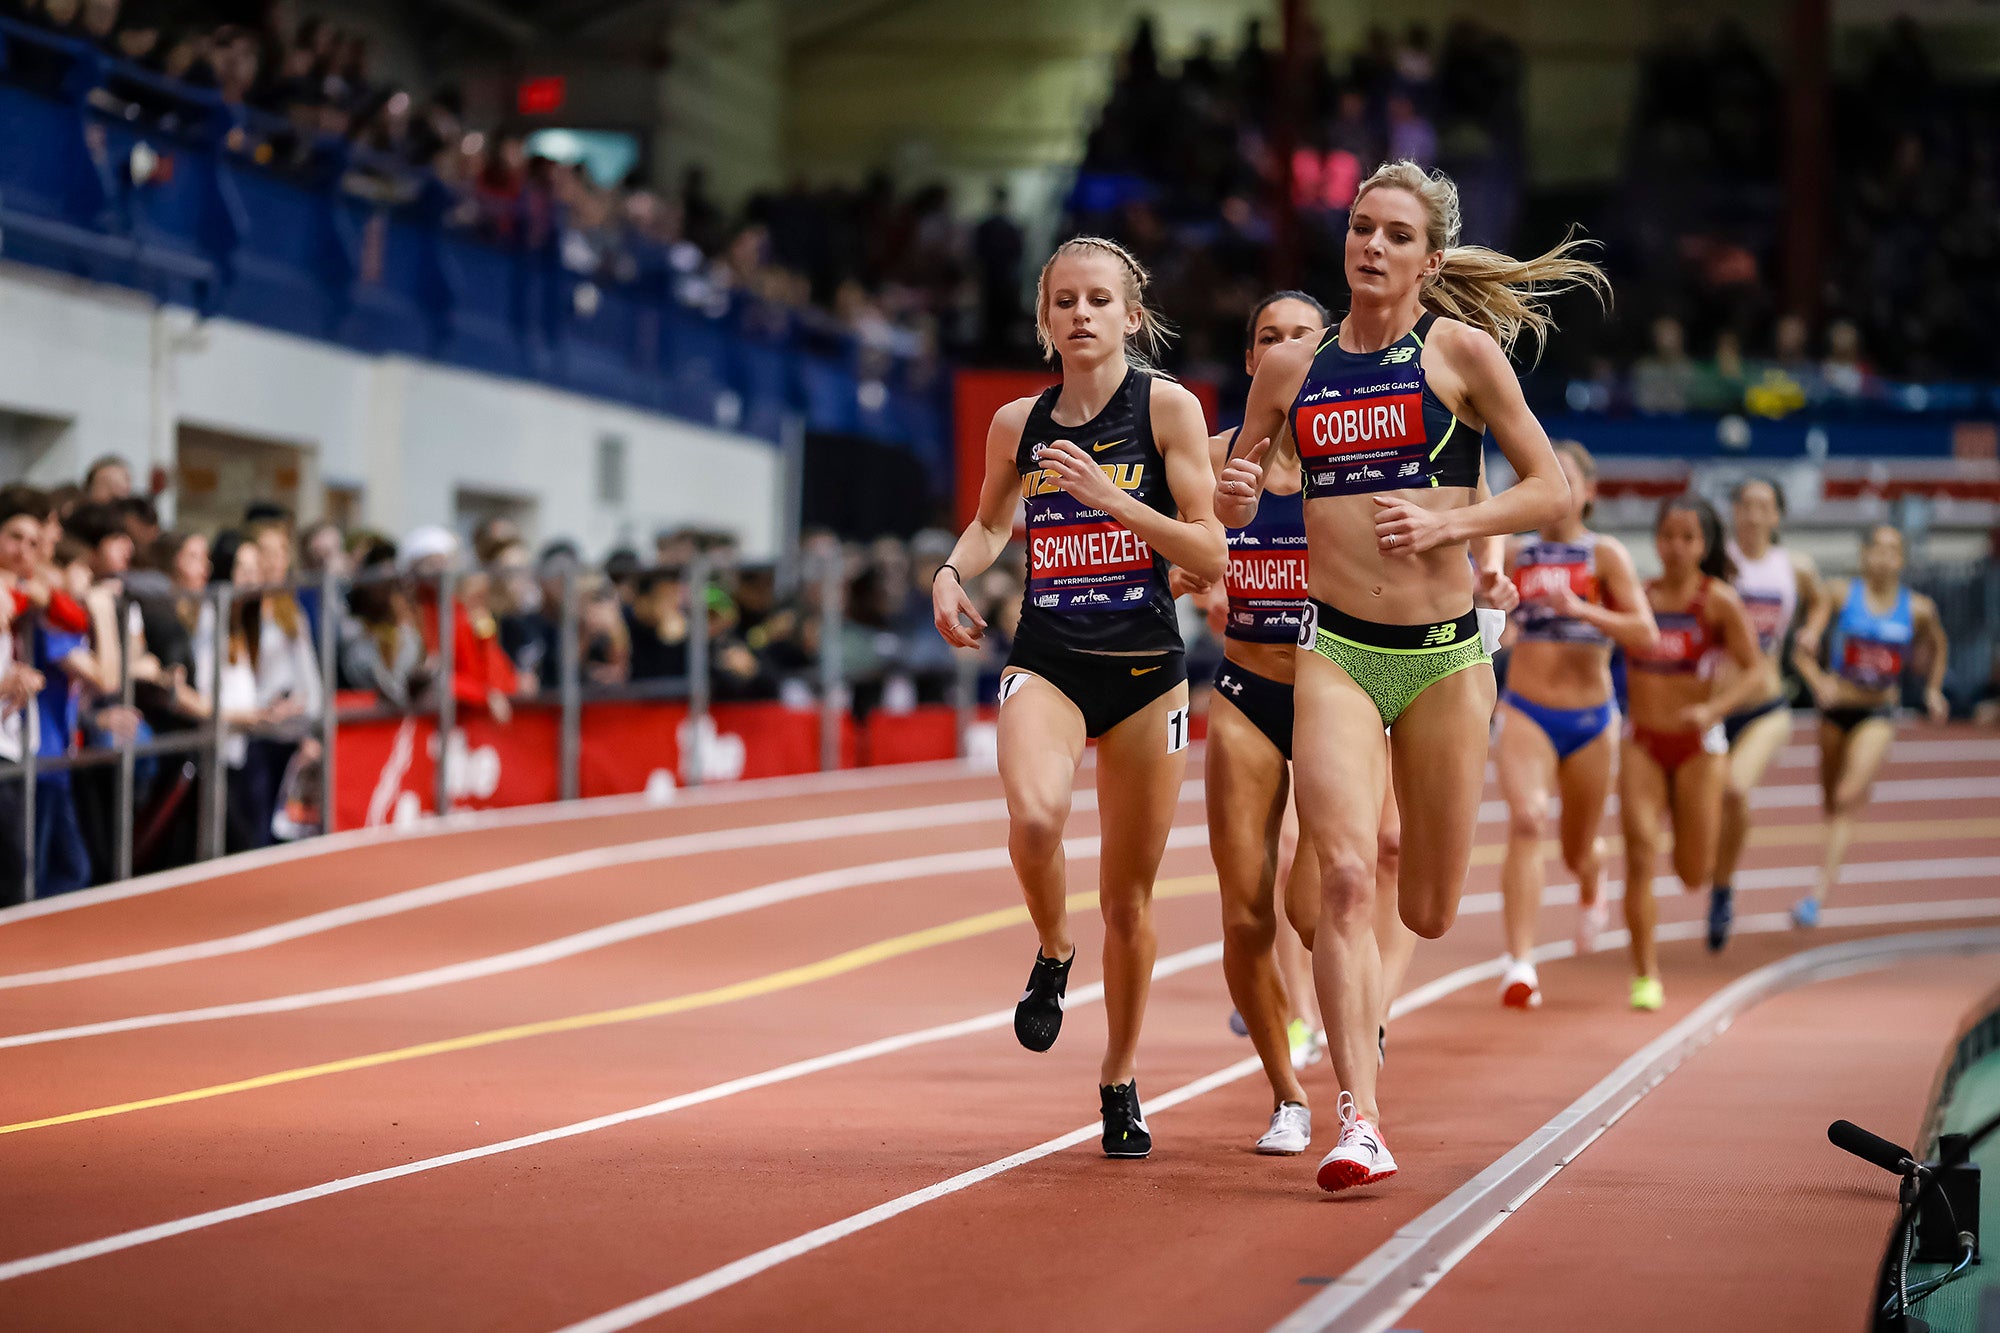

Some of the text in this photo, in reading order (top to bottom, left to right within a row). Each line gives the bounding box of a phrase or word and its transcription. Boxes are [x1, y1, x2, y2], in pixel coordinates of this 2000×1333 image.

[1353, 381, 1420, 395] MILLROSE GAMES
[1312, 403, 1407, 447] COBURN
[1328, 450, 1399, 463] #NYRRMillroseGames
[1033, 529, 1150, 570] SCHWEIZER
[1053, 574, 1126, 586] #NYRRMillroseGames
[1299, 603, 1315, 646] 3
